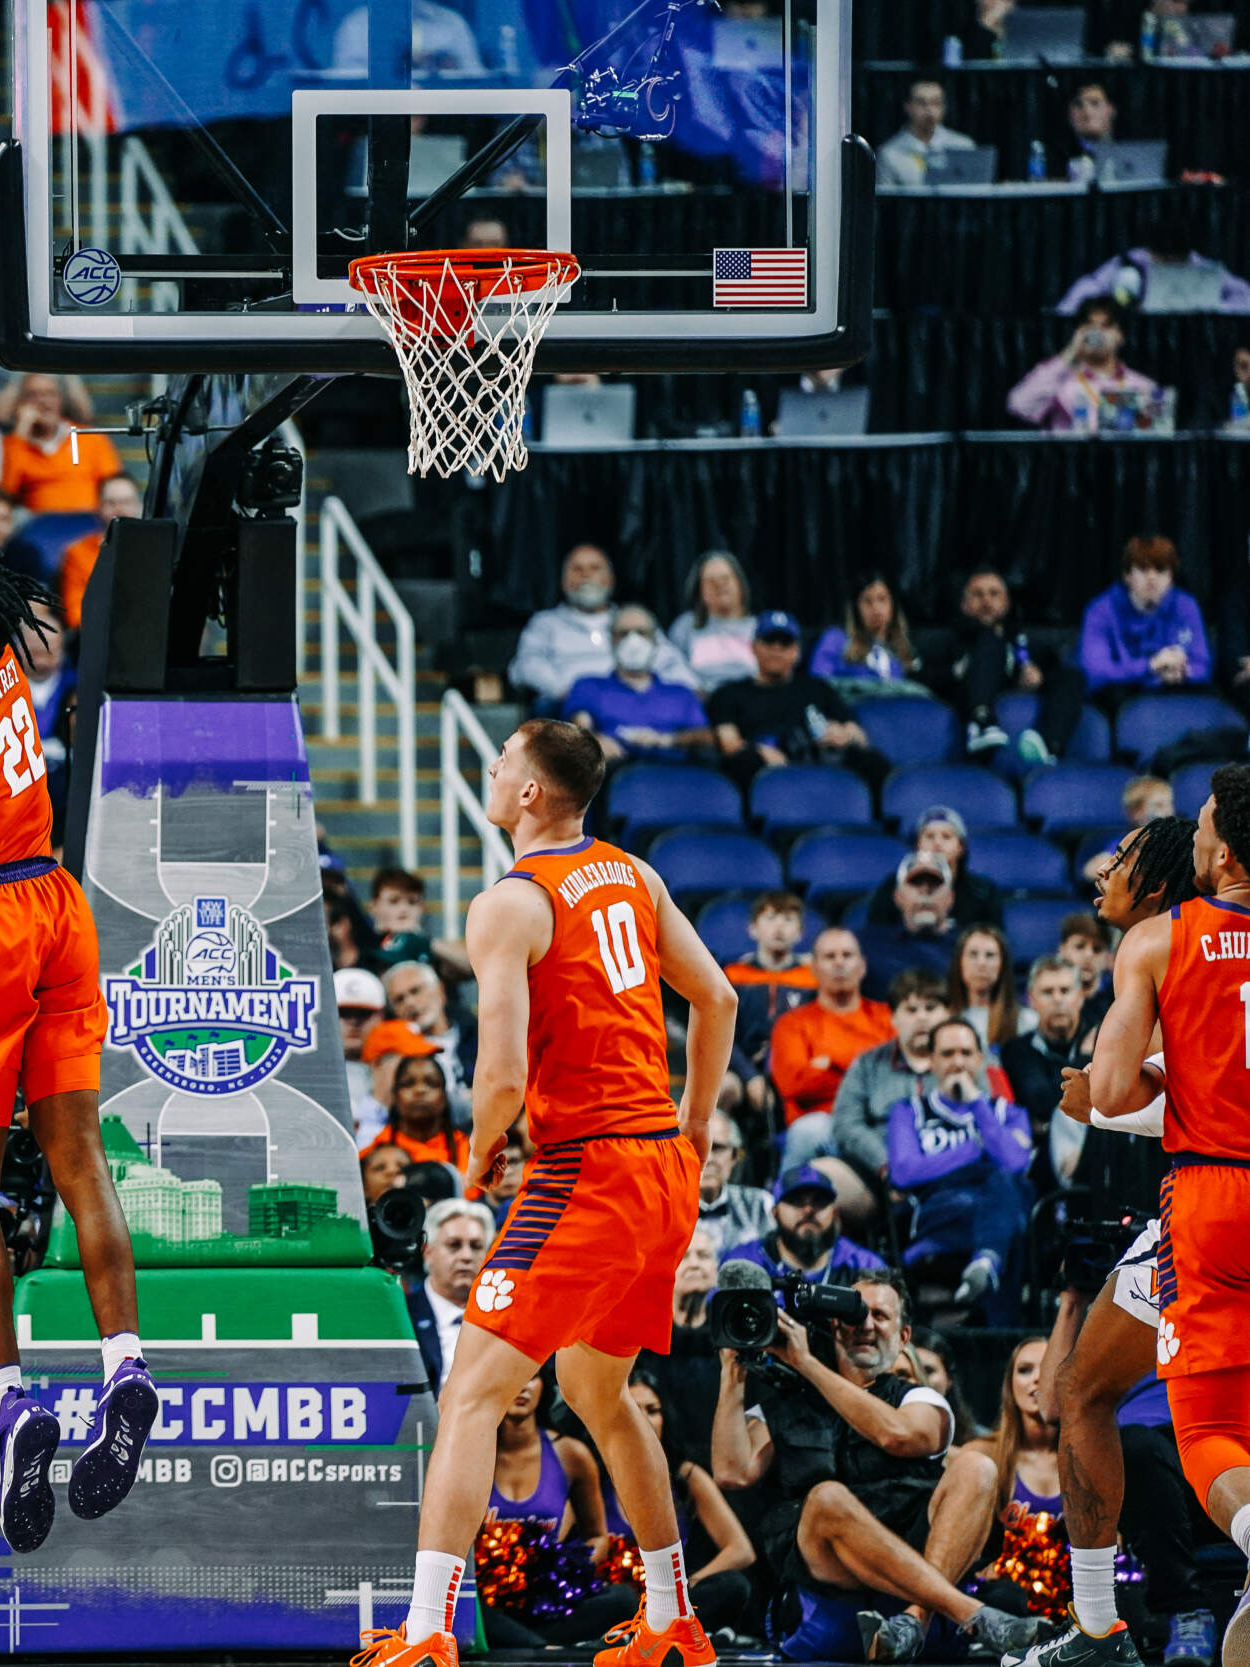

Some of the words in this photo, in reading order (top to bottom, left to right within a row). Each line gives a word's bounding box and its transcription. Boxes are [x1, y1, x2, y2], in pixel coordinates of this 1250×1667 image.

[70, 266, 119, 280] ACC
[558, 861, 637, 909] MIDDLEBROOKS
[192, 949, 234, 960] ACC
[591, 901, 646, 995] 10
[1200, 931, 1250, 962] C.HU
[187, 975, 236, 986] MEN'S
[110, 982, 311, 1039] TOURNAMENT
[53, 1387, 367, 1440] #CCMBB
[49, 1459, 192, 1483] @MBB
